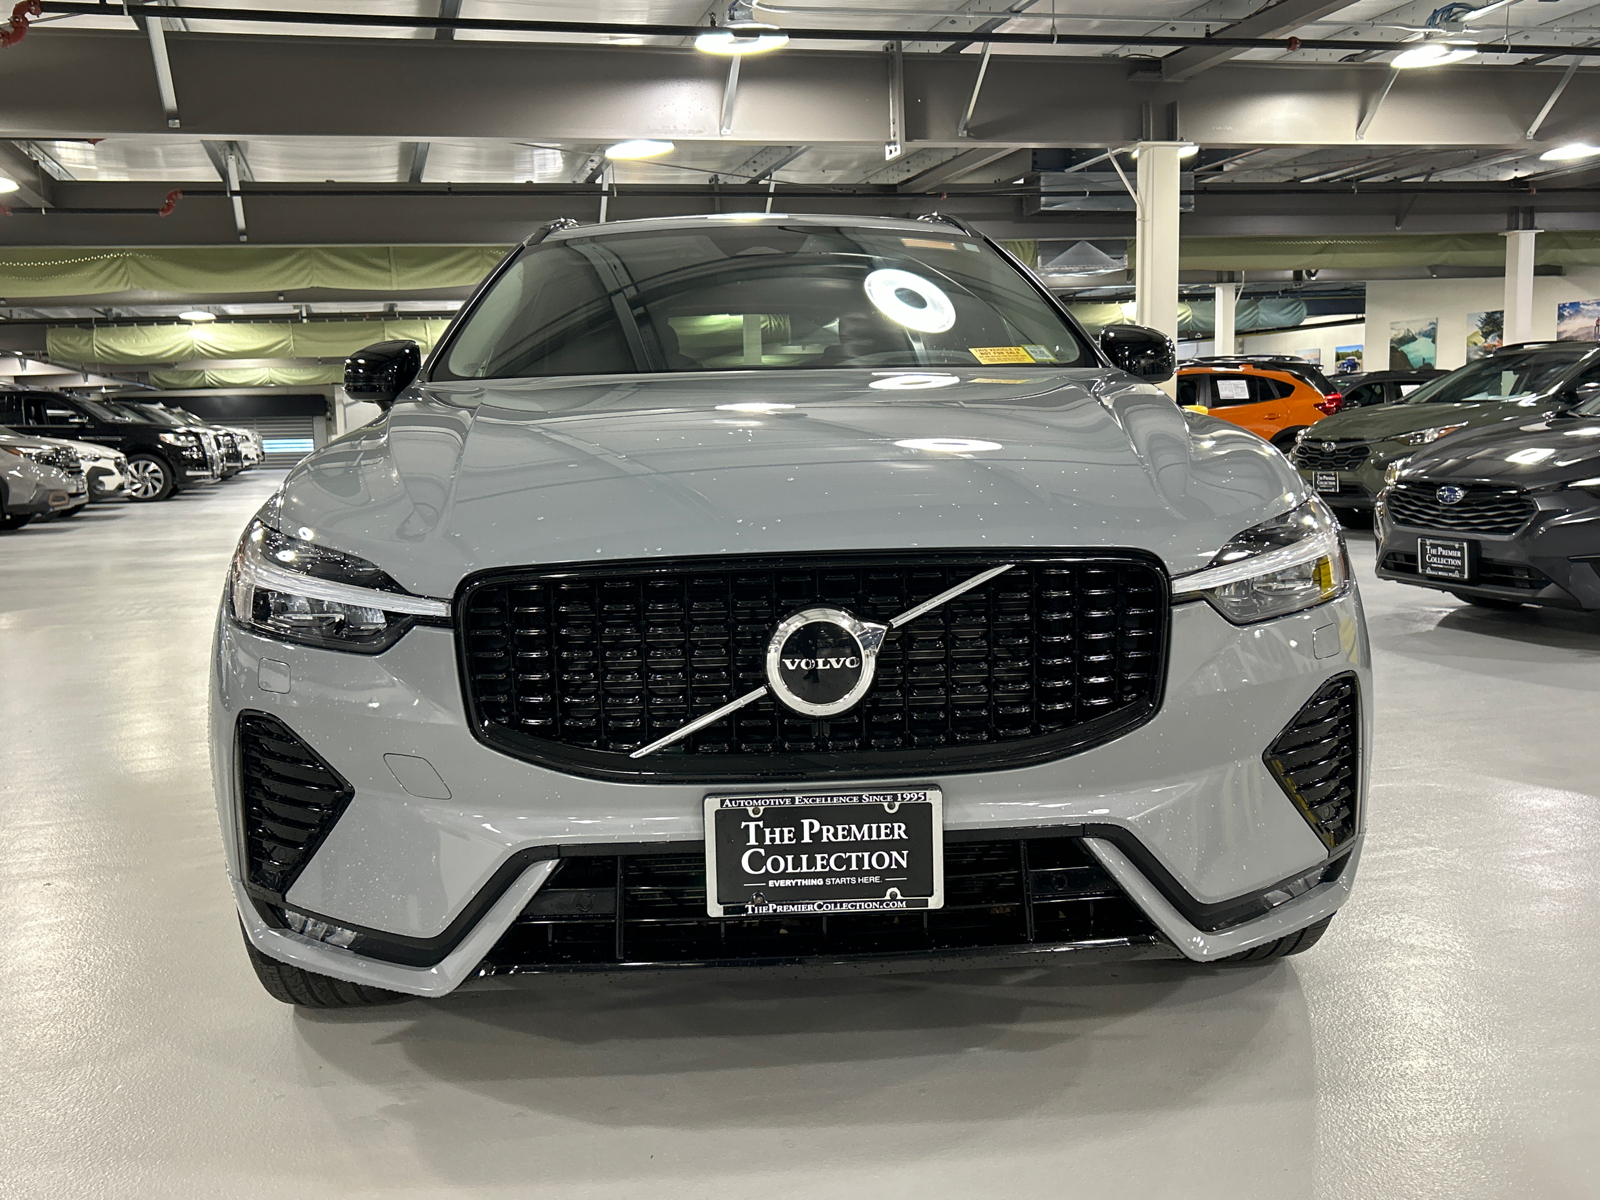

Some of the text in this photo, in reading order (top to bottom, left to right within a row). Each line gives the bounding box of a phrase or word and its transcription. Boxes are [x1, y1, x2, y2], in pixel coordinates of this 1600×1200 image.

[1426, 546, 1461, 557] THE PREMIER
[1426, 554, 1462, 566] COLLECTION
[782, 656, 860, 670] VOLVO
[722, 792, 925, 808] AUTOMOTIVE EXCELLENCE SINCE 1995
[741, 818, 908, 845] THE PREMIER
[741, 848, 908, 874] COLLECTION
[768, 876, 882, 887] EVERYTHING STARTS HERE.
[745, 901, 906, 914] THEPREMIERCOLLECTION.COM
